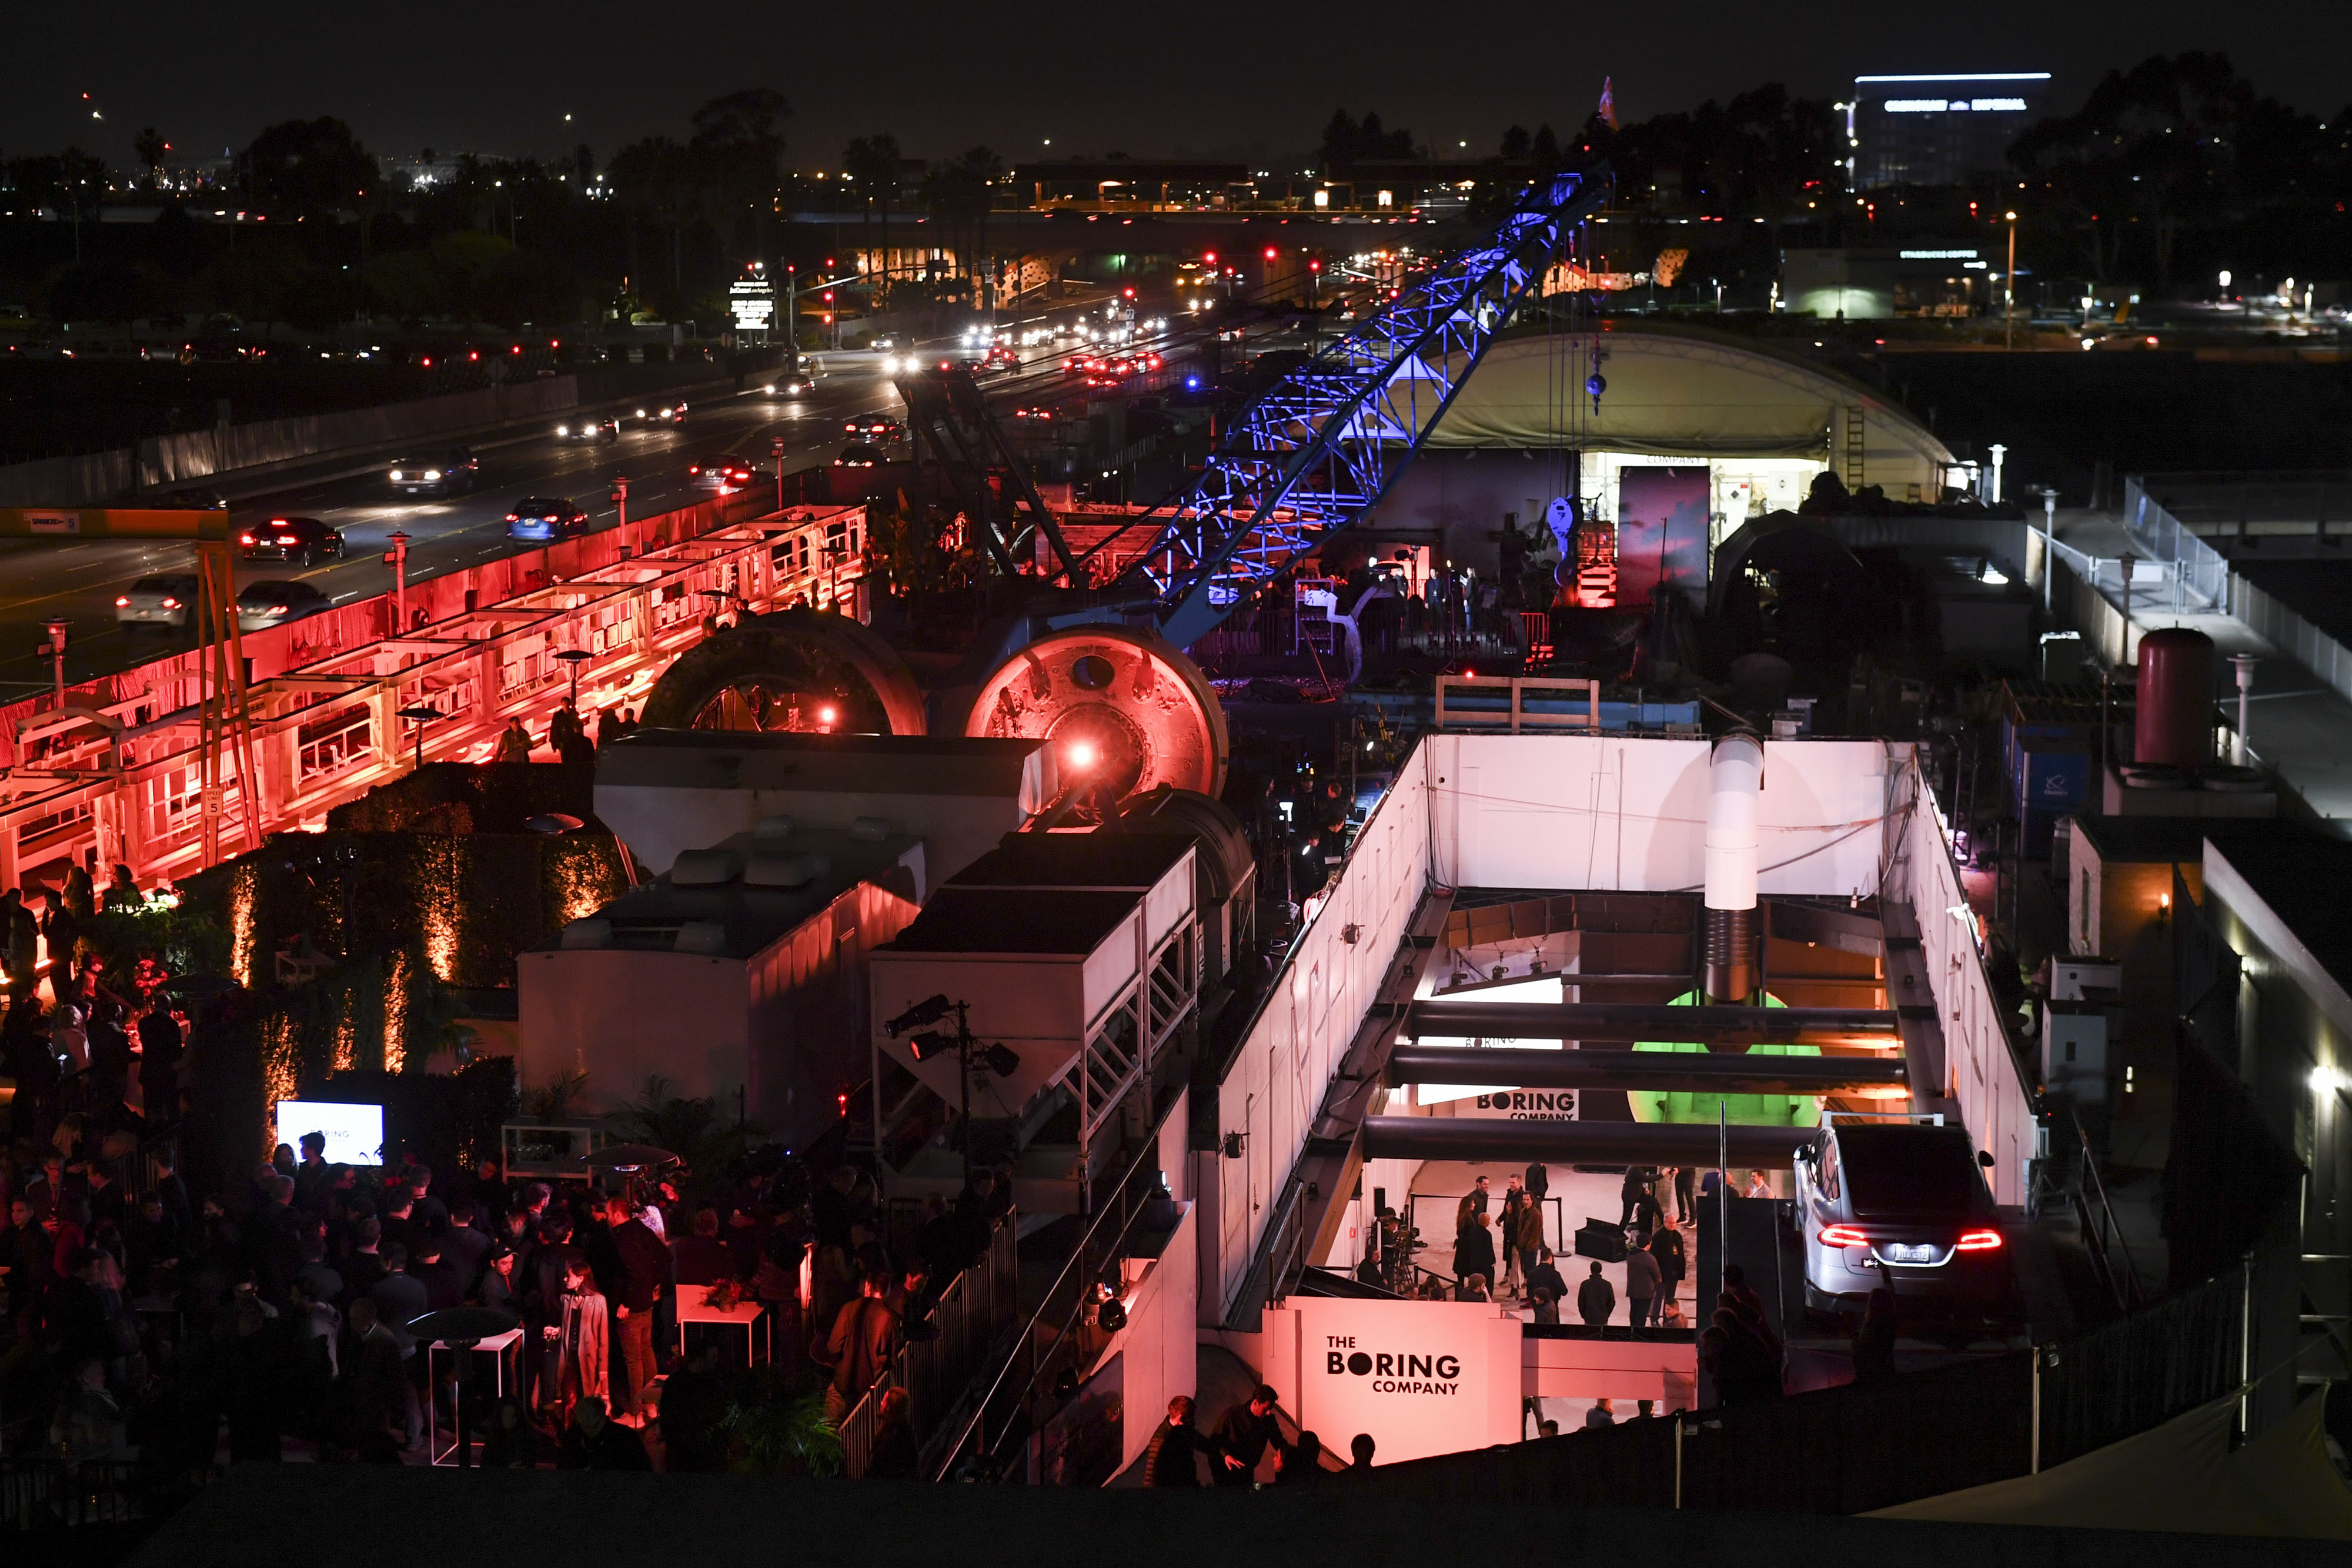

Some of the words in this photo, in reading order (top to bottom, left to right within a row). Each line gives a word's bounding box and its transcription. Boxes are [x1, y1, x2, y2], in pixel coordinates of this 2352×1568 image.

[1647, 455, 1700, 464] COMPANY
[211, 804, 218, 813] 5
[1477, 1092, 1575, 1111] BORING
[1327, 1336, 1356, 1348] THE
[1327, 1352, 1461, 1379] BORING
[1372, 1380, 1459, 1395] COMPANY
